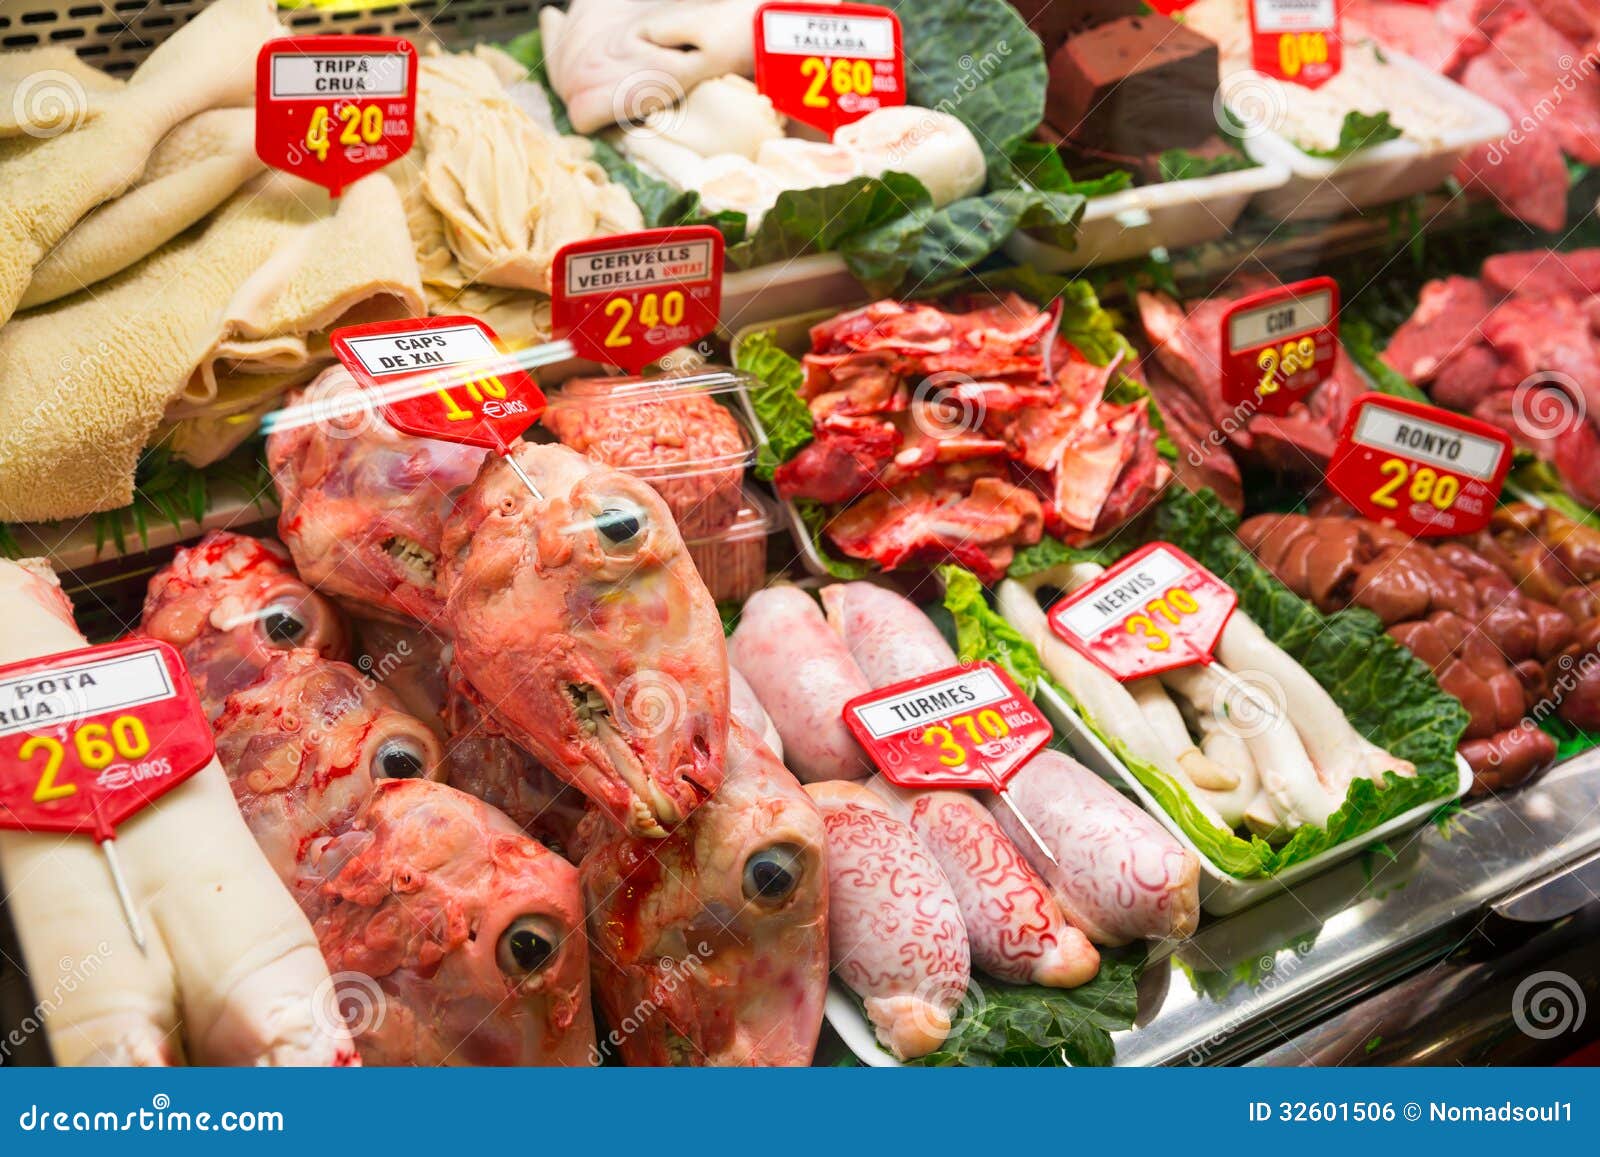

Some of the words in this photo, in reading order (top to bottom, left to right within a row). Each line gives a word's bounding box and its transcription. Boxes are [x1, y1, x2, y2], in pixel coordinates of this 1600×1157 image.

[808, 21, 850, 33] POTA
[794, 35, 866, 49] TALLADA
[314, 60, 369, 73] TRIPA
[315, 78, 366, 91] CRUA
[590, 248, 690, 271] CERVELLS
[578, 268, 656, 288] VEDELLA
[1267, 309, 1296, 333] COR
[395, 335, 447, 351] CAPS
[379, 355, 409, 369] DE
[409, 351, 444, 366] XAI
[1093, 572, 1156, 616] NERVIS
[14, 672, 97, 700] POTA
[890, 684, 976, 722] TURMES
